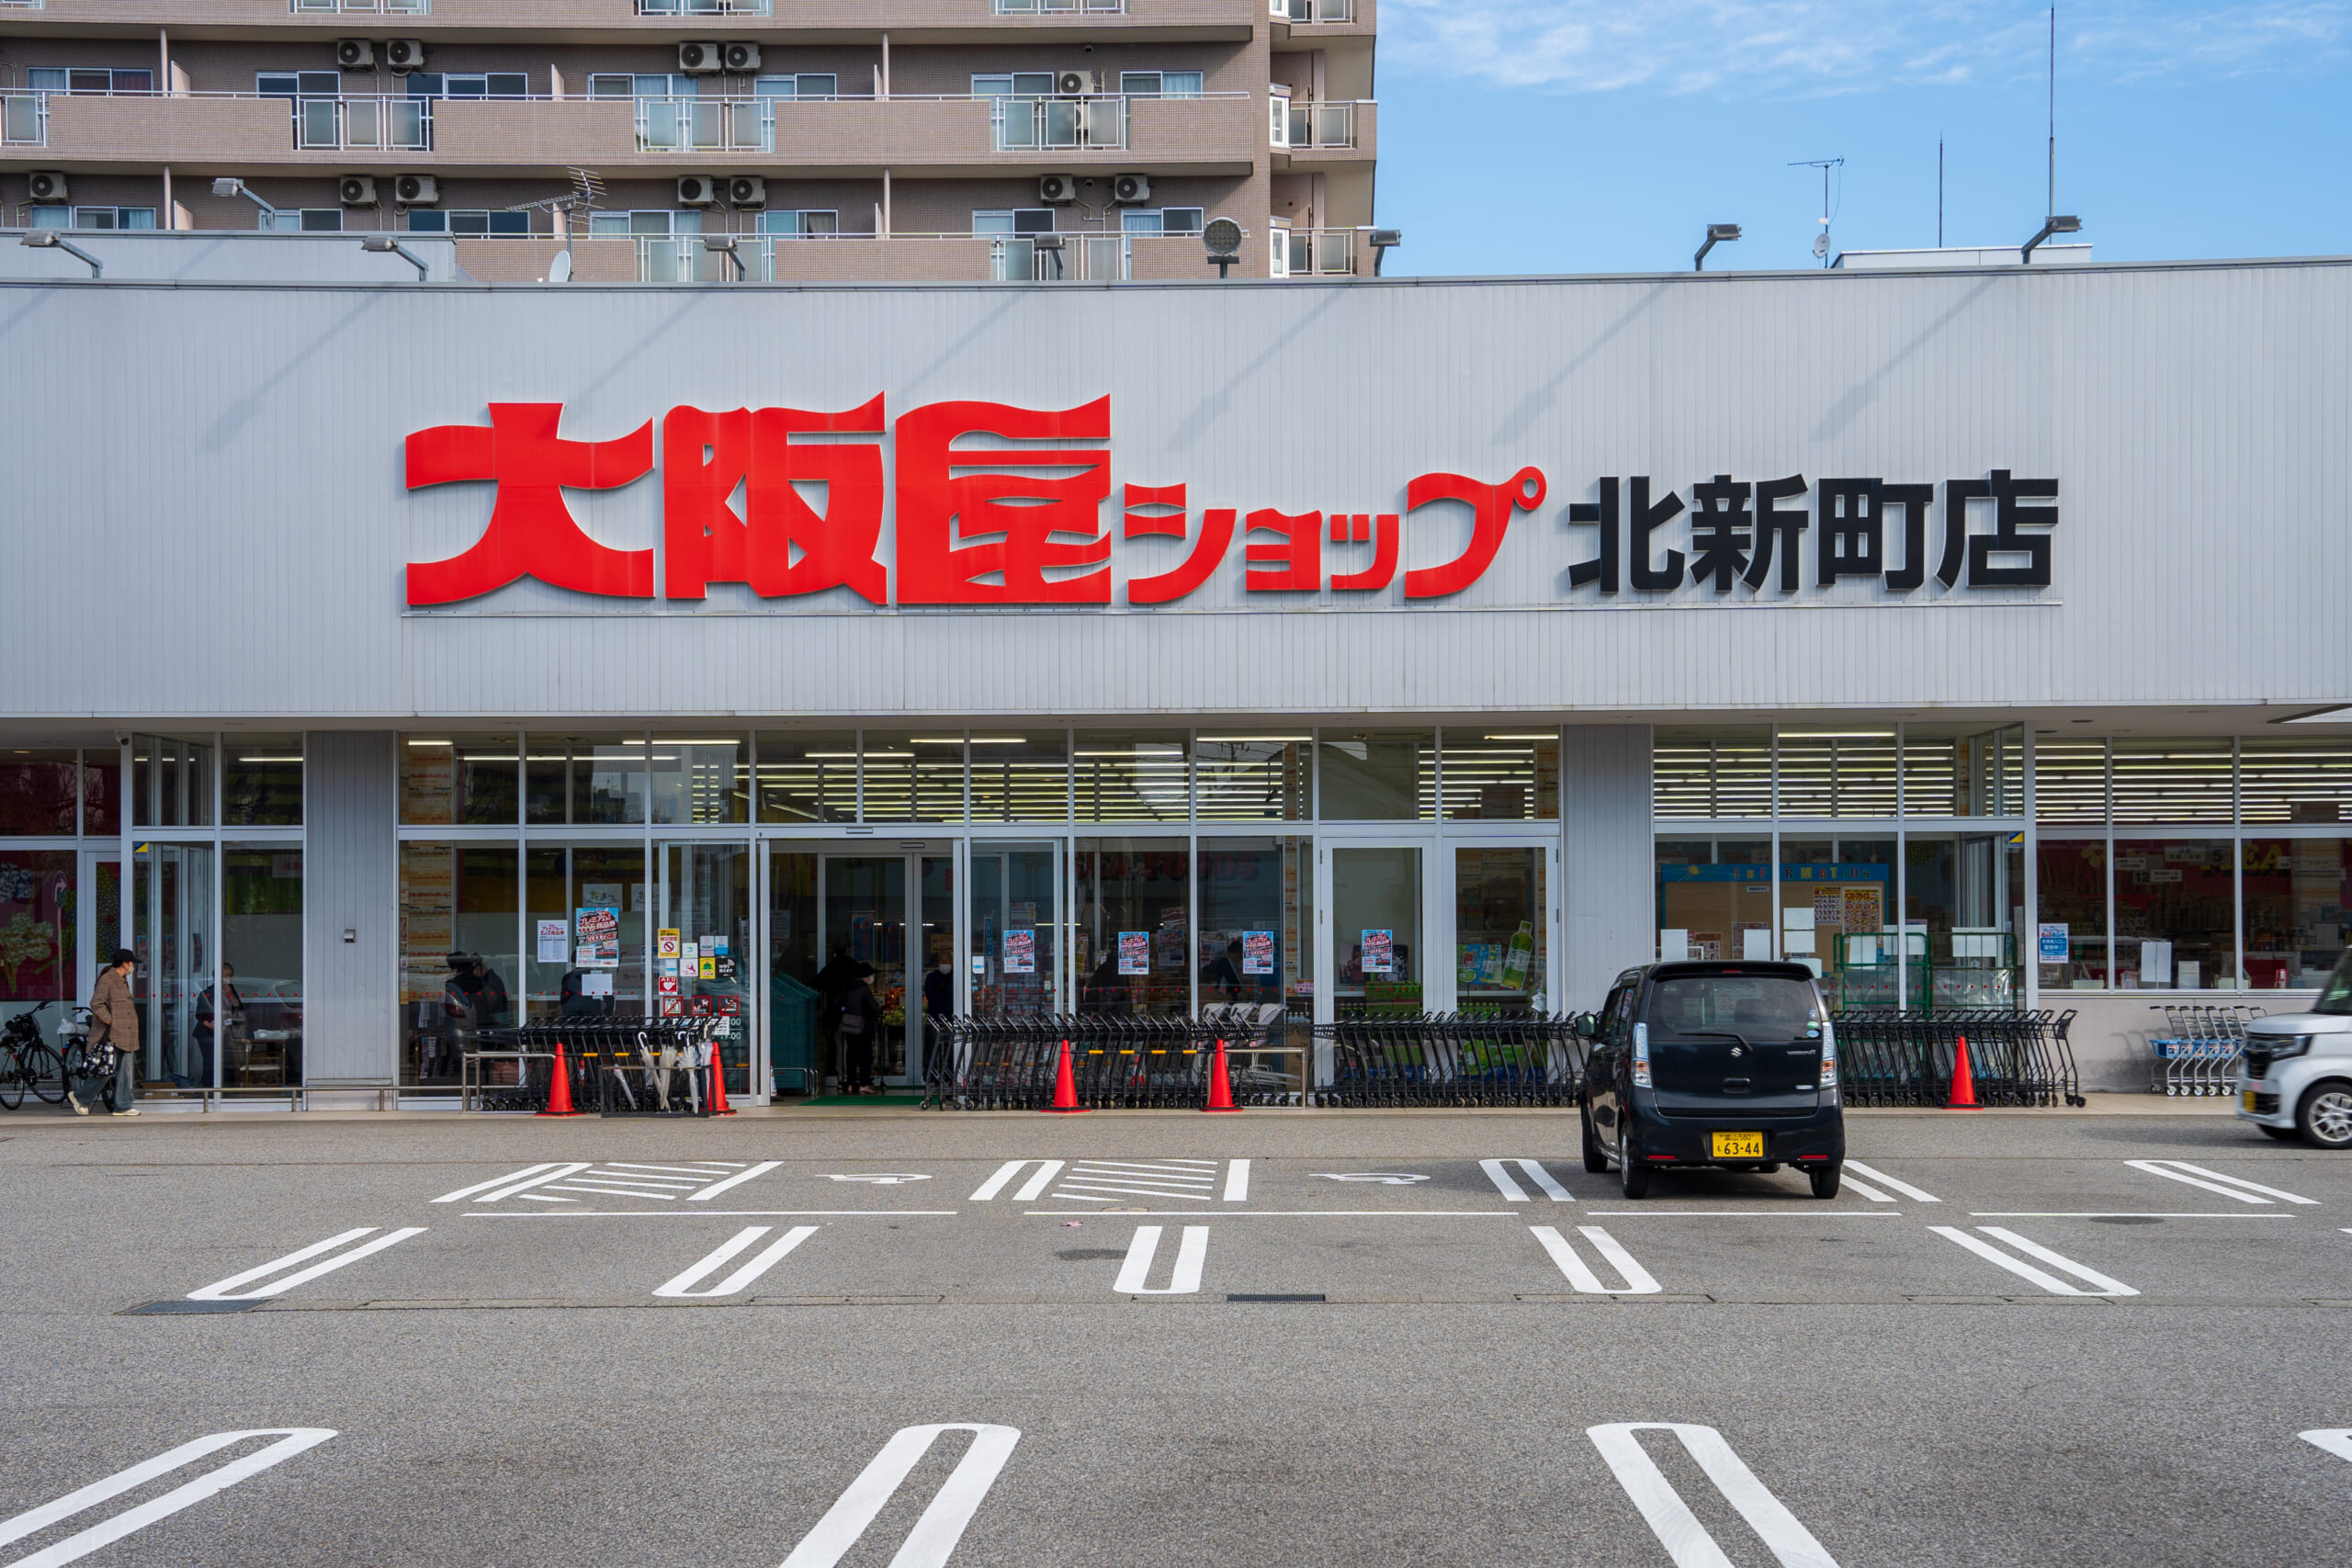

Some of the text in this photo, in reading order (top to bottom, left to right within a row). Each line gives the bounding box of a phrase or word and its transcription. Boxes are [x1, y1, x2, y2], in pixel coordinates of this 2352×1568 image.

[406, 391, 2060, 606] 大阪屋ショップ 北新町店
[1734, 866, 1871, 879] INFRMATION
[2135, 873, 2150, 883] 12
[1724, 1142, 1759, 1155] 63-44
